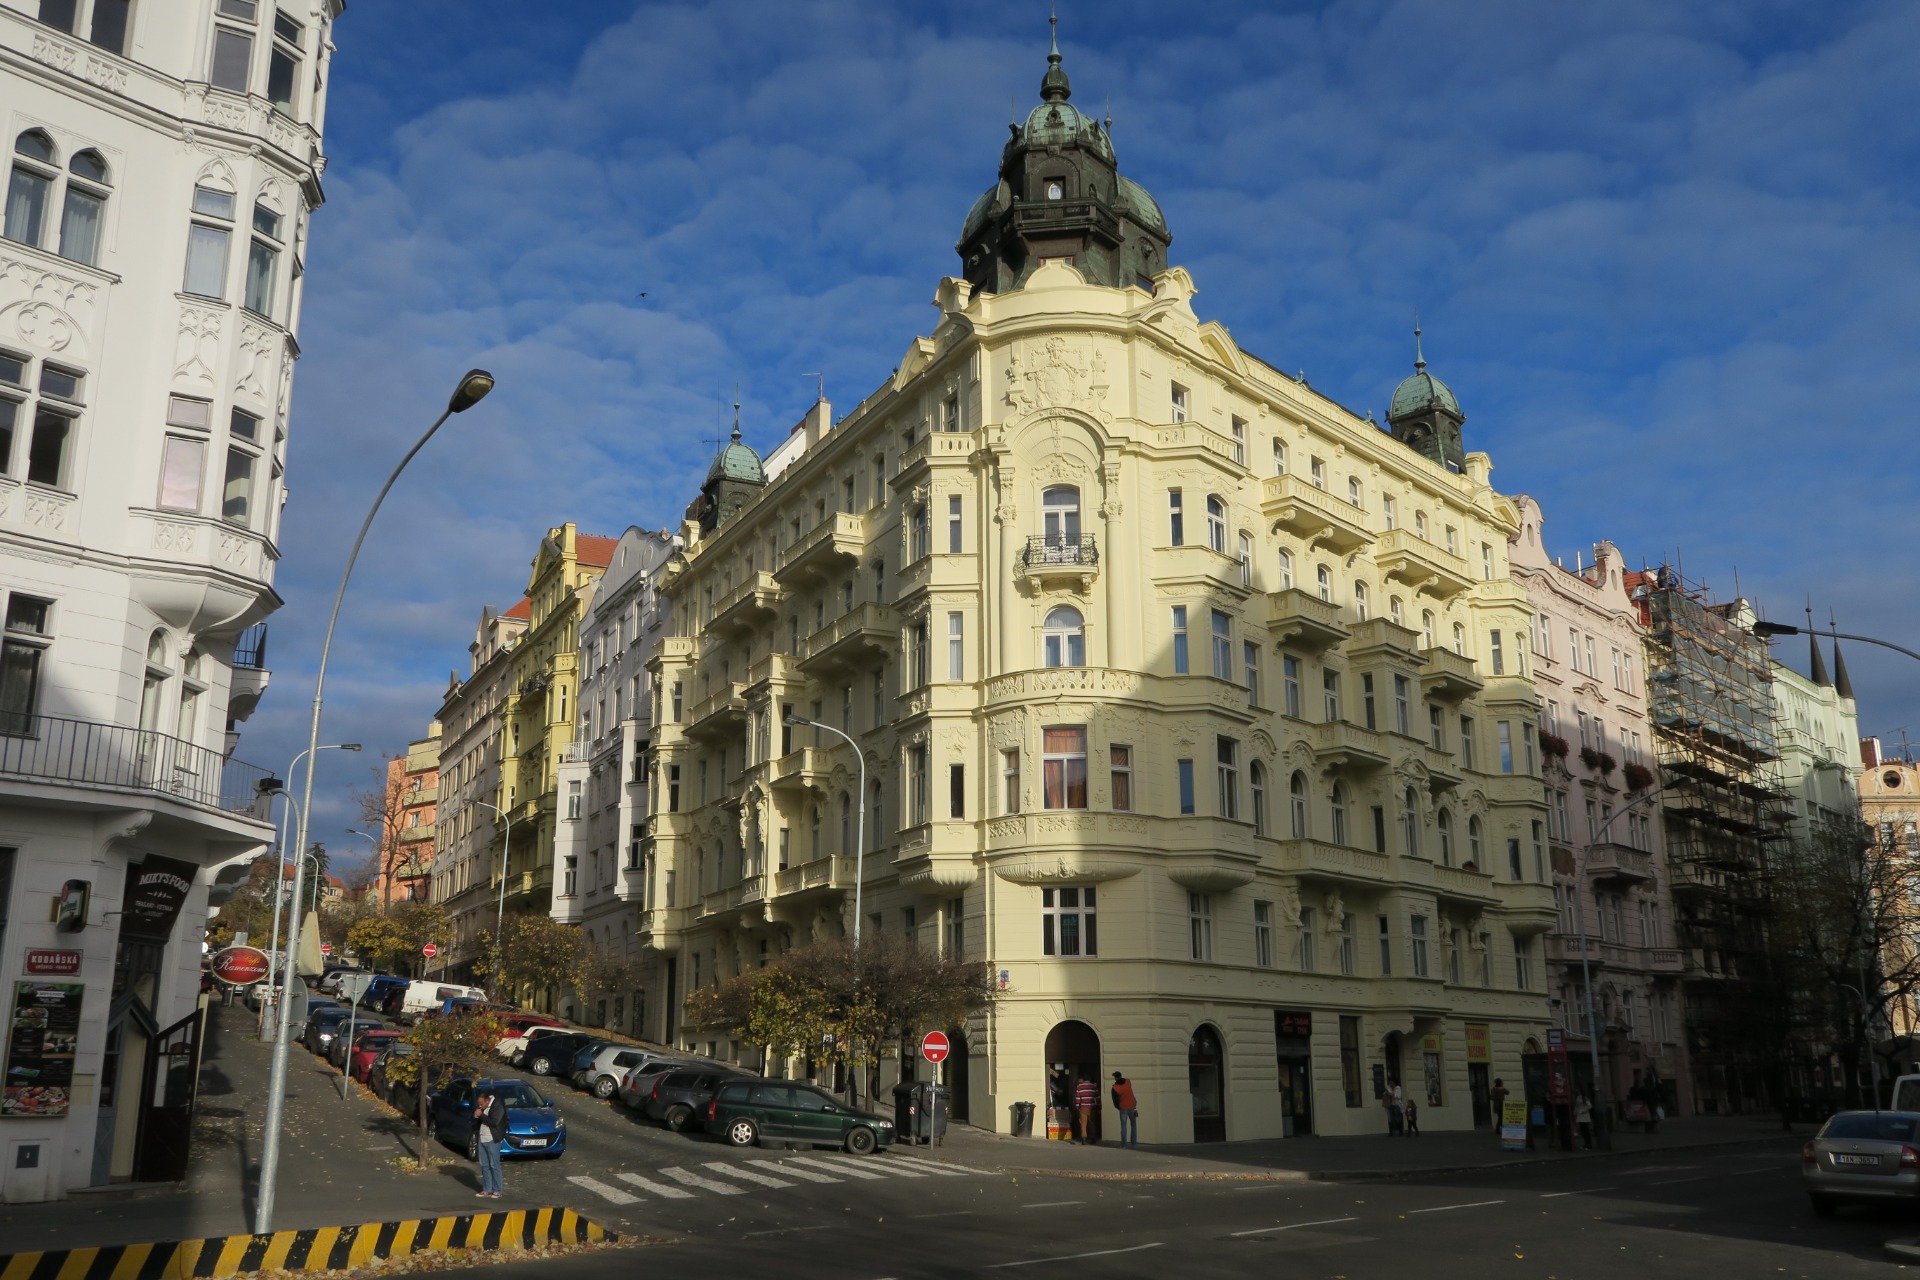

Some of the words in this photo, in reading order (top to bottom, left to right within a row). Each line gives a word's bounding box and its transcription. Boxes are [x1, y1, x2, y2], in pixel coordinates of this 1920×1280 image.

[138, 872, 171, 885] MIKY'S
[168, 874, 190, 893] FOOD
[31, 954, 78, 964] KODAŇSKÁ
[214, 956, 268, 972] Ramenzoni
